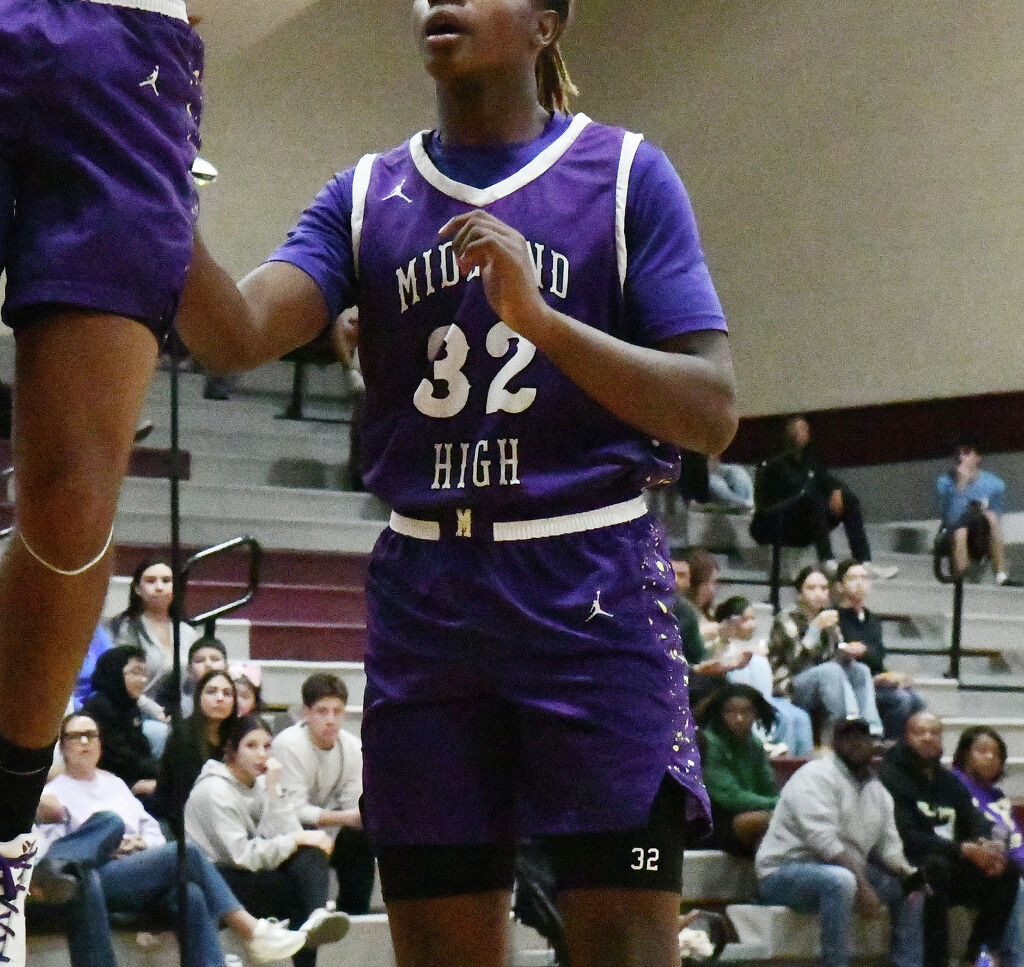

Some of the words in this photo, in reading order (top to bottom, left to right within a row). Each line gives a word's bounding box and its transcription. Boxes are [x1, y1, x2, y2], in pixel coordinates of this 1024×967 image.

[395, 240, 570, 314] MIDND
[413, 323, 537, 418] 32
[431, 439, 521, 490] HIGH
[455, 508, 472, 538] M
[630, 847, 660, 871] 32
